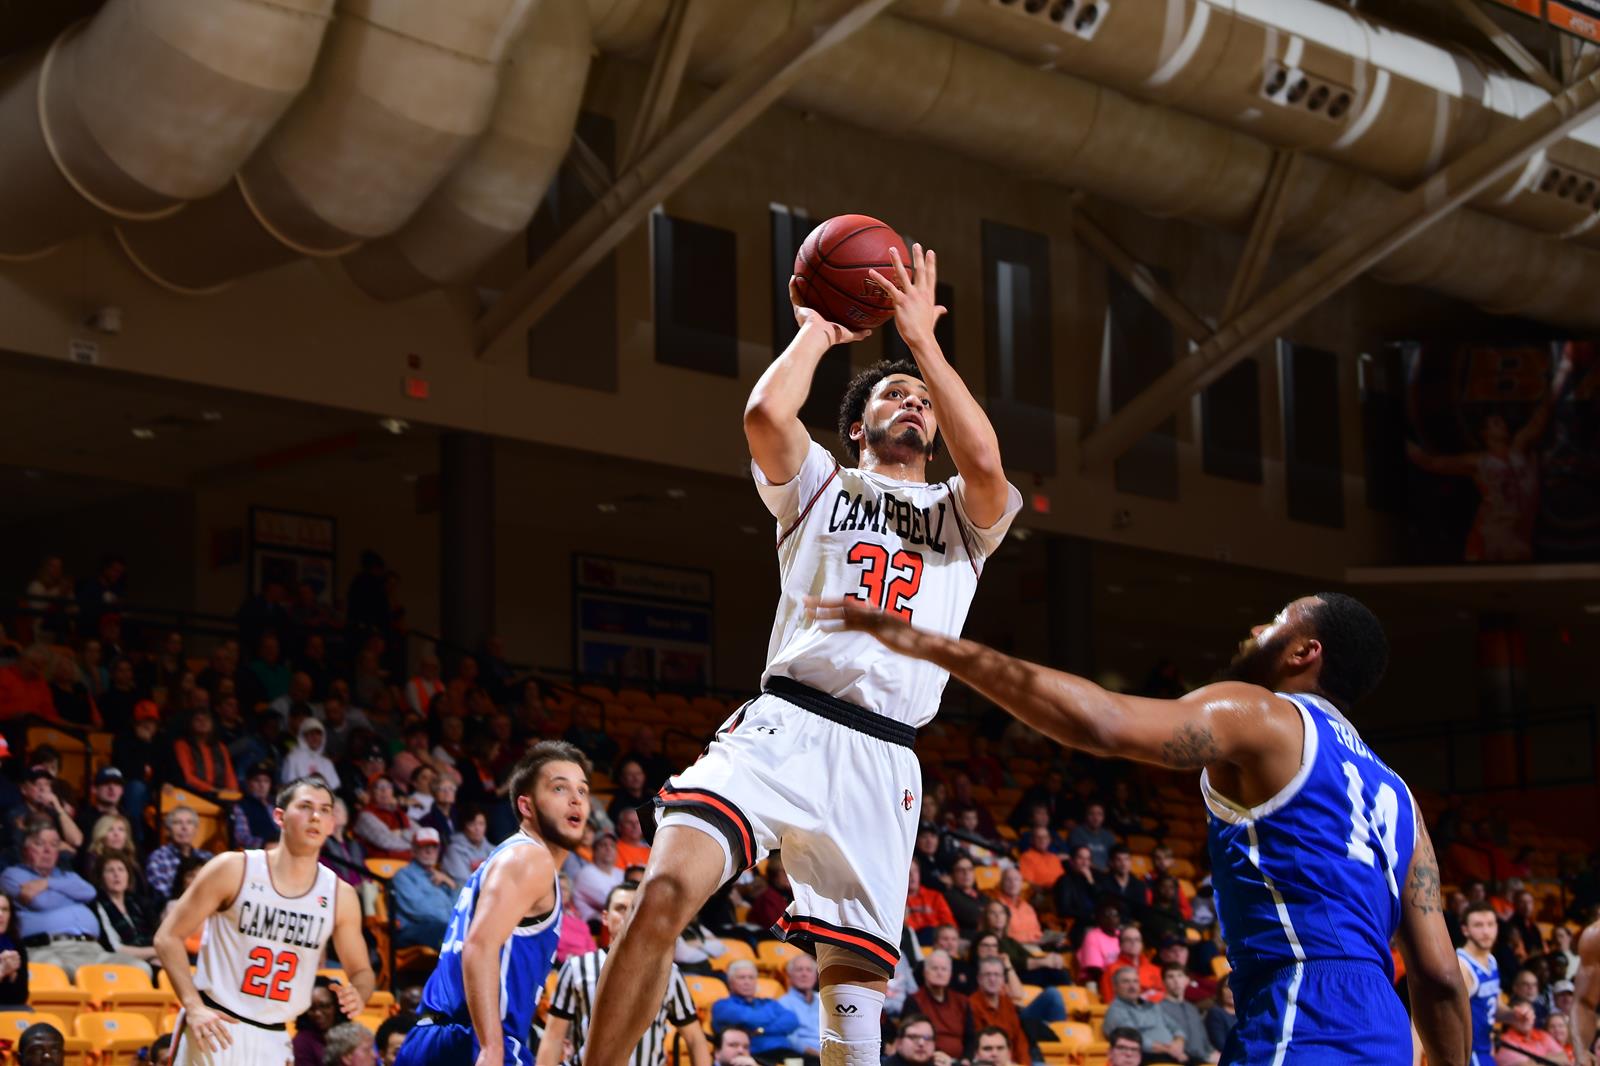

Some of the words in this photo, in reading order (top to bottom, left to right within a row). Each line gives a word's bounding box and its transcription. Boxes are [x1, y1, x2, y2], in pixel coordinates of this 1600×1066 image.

[829, 489, 946, 555] CAMPBELL
[844, 541, 924, 624] 32
[239, 901, 324, 949] CAMPBELL
[241, 945, 299, 1002] 22
